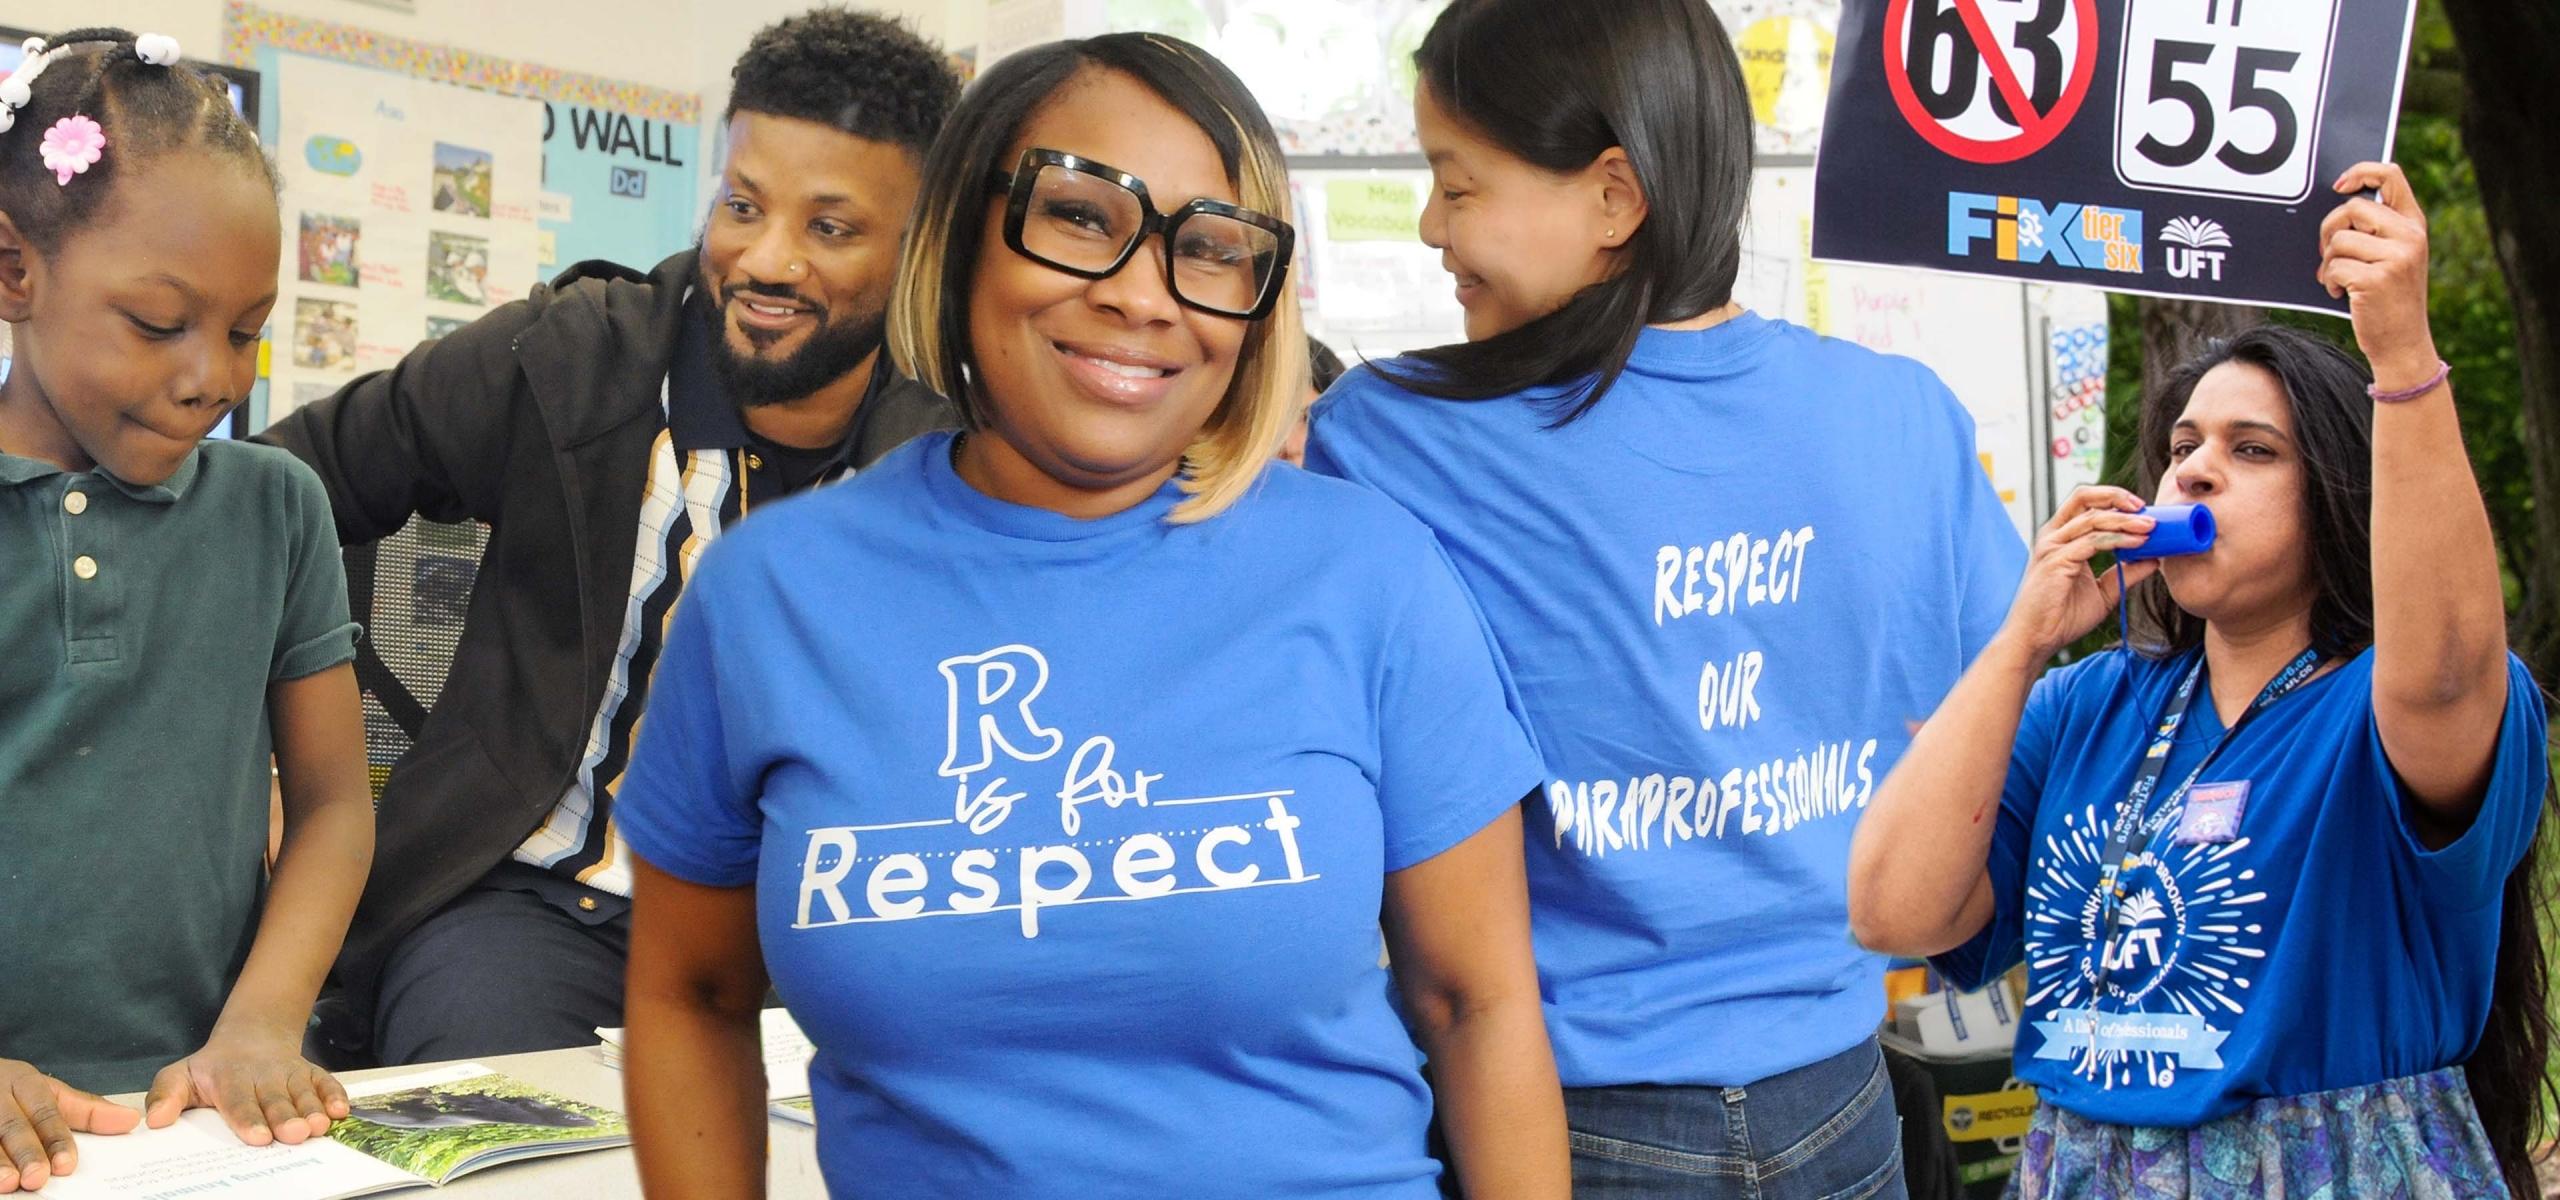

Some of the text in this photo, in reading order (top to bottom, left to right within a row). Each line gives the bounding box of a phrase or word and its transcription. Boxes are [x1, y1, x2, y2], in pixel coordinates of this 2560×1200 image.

[571, 107, 683, 167] WALL
[2134, 39, 2302, 176] 55
[613, 168, 644, 196] Dd
[2082, 204, 2124, 241] tier
[2104, 241, 2143, 273] six
[2165, 247, 2226, 281] UFT
[1654, 526, 1815, 626] RESPECT
[938, 644, 1064, 777] R
[1699, 650, 1763, 731] OUR
[955, 735, 1164, 836] is for
[1550, 738, 1878, 859] PARAPROFESSIONALS
[797, 797, 1301, 939] Respect
[2155, 860, 2187, 936] BROOKLYN
[2101, 928, 2162, 970] UFT
